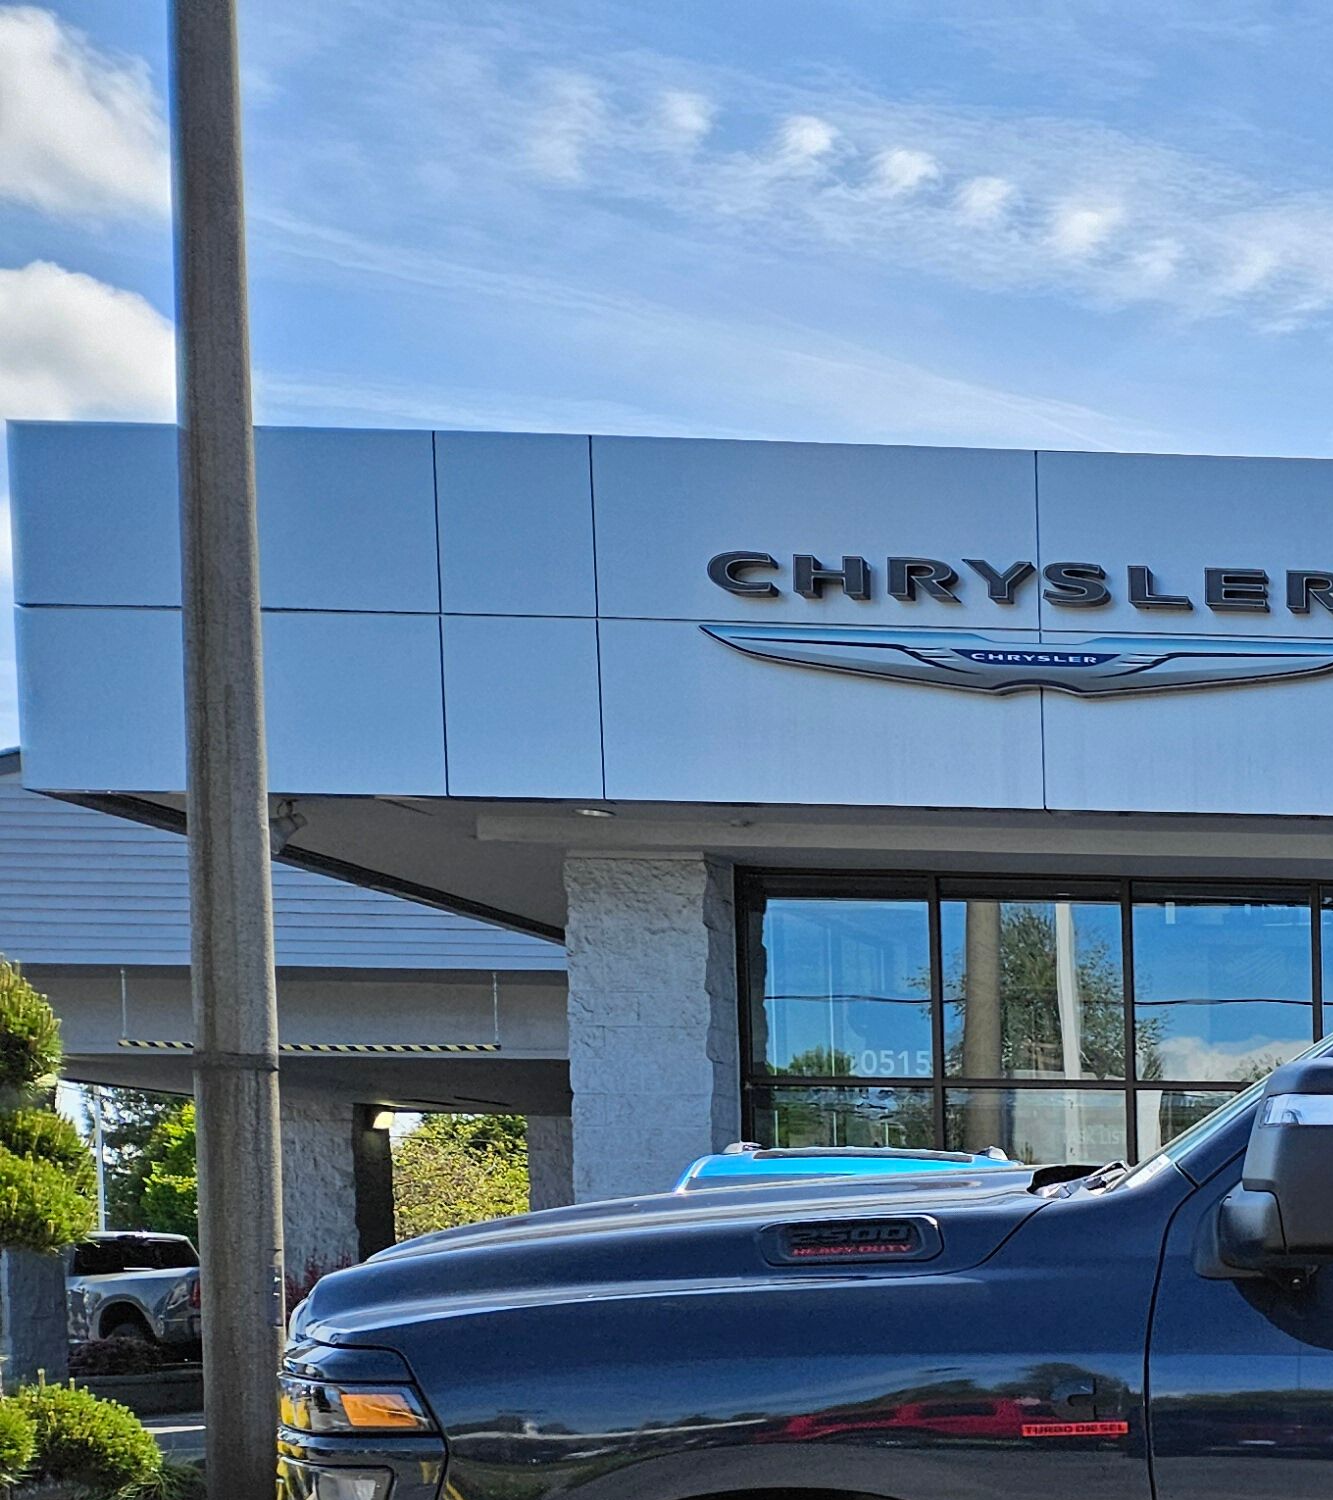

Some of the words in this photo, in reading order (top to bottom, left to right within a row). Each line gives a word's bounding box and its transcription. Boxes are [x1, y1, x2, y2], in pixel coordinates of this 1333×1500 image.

[969, 651, 1099, 667] CHRYSLER
[791, 1225, 912, 1246] 2500
[792, 1244, 856, 1257] HEAVY
[858, 1243, 912, 1254] DUTY
[1024, 1423, 1074, 1435] TURBO
[1075, 1422, 1127, 1434] DIESEL
